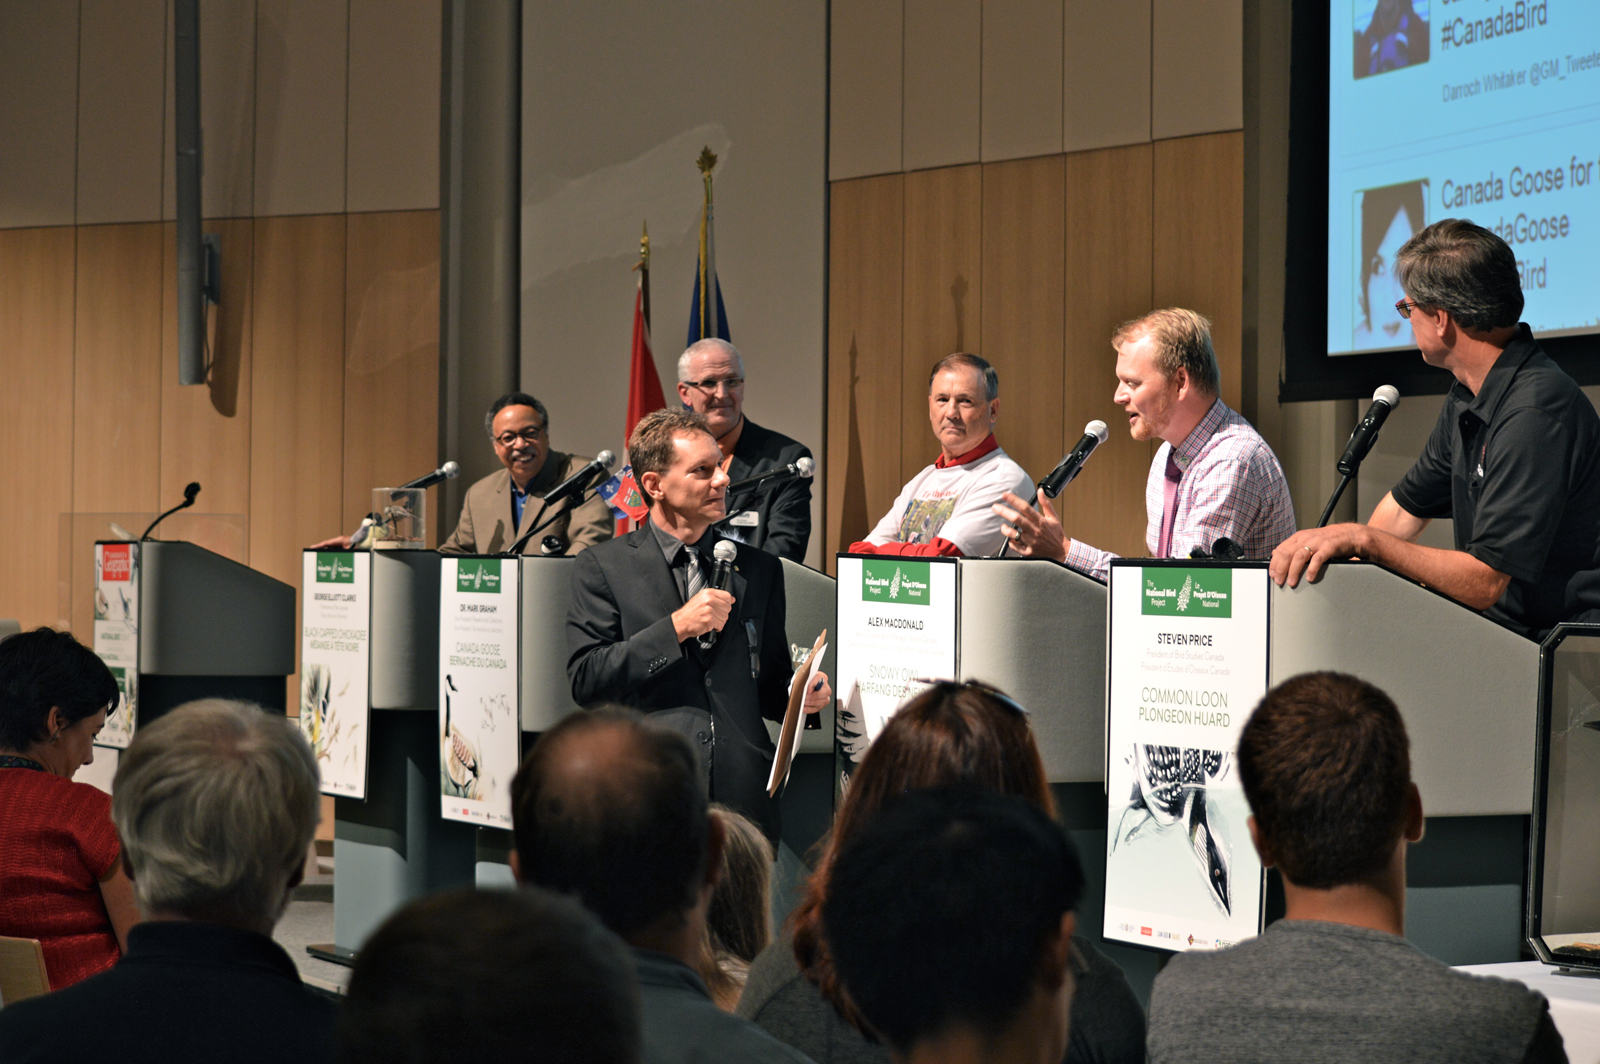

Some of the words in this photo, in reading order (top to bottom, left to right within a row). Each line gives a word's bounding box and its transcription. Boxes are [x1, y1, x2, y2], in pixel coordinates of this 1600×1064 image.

[1441, 0, 1548, 50] #CanadaBird
[1442, 77, 1481, 103] Darroch
[1483, 68, 1528, 93] Whitaker
[1442, 171, 1504, 209] Canada
[1509, 165, 1565, 198] Goose
[1569, 154, 1594, 188] for
[1489, 212, 1570, 246] daGoose
[1145, 587, 1166, 597] National
[1166, 588, 1176, 598] Bird
[1193, 588, 1207, 600] Projet
[1151, 598, 1166, 608] Project
[1202, 600, 1220, 608] National
[868, 617, 884, 627] ALEX
[884, 618, 924, 631] MACDONALD
[1157, 632, 1188, 646] STEVEN
[1189, 634, 1213, 647] PRICE
[456, 642, 480, 654] CANADA
[480, 643, 501, 656] GOOSE
[1204, 650, 1225, 662] Canada
[449, 655, 477, 667] BERNACHE
[485, 657, 508, 669] CANADA
[869, 664, 900, 680] SNOWY
[1209, 664, 1231, 676] Canada
[855, 680, 891, 697] HARFANG
[892, 684, 907, 698] DES
[1141, 687, 1193, 706] COMMON
[1195, 690, 1228, 709] LOON
[1138, 706, 1192, 725] PLONGEON
[1193, 711, 1231, 728] HUARD
